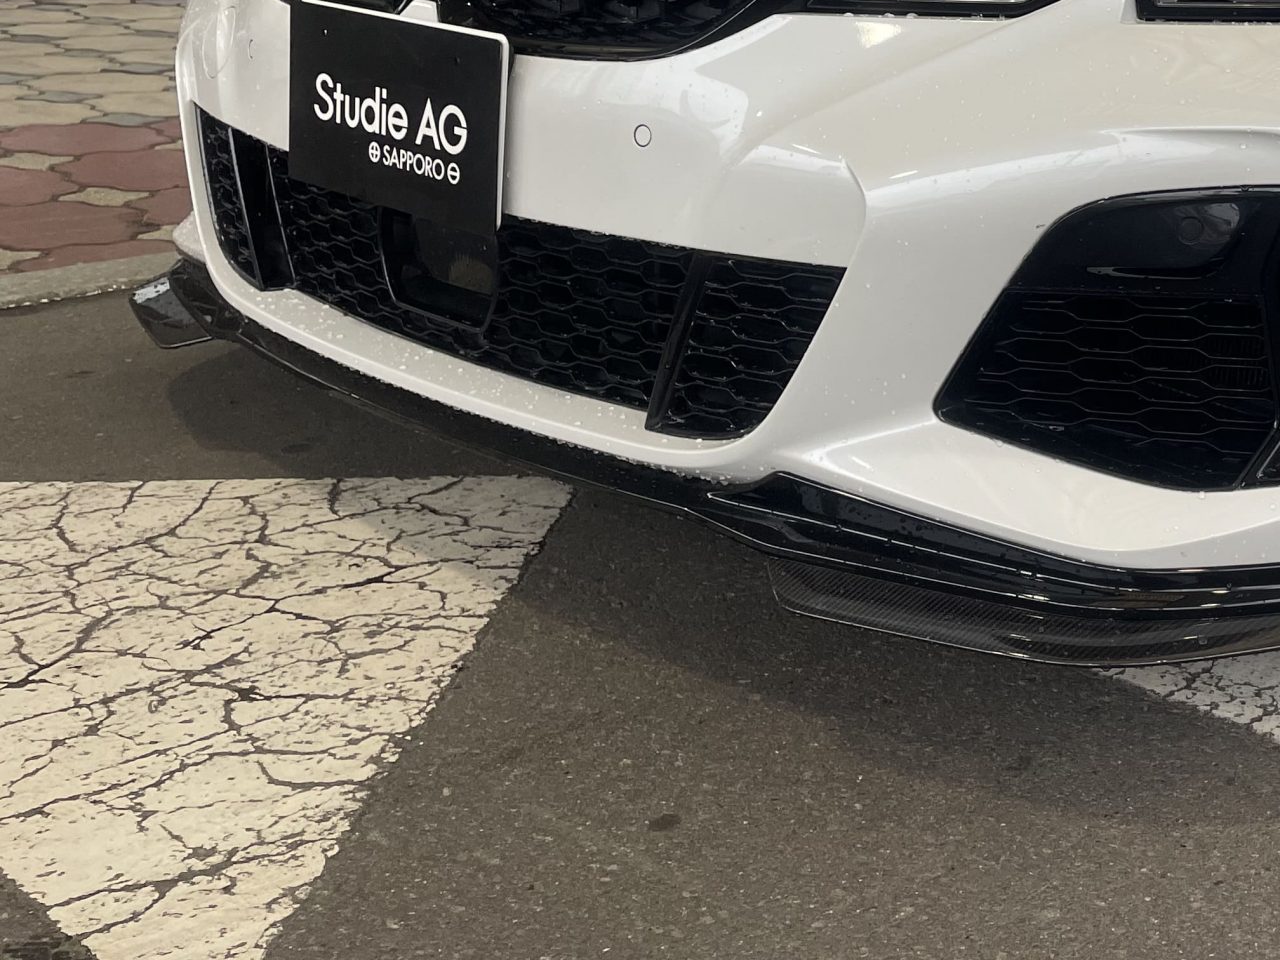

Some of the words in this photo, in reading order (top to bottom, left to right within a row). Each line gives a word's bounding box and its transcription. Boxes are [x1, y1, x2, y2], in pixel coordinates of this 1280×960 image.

[313, 72, 408, 141] Studie
[415, 97, 468, 155] AG
[382, 145, 445, 178] SAPPORO
